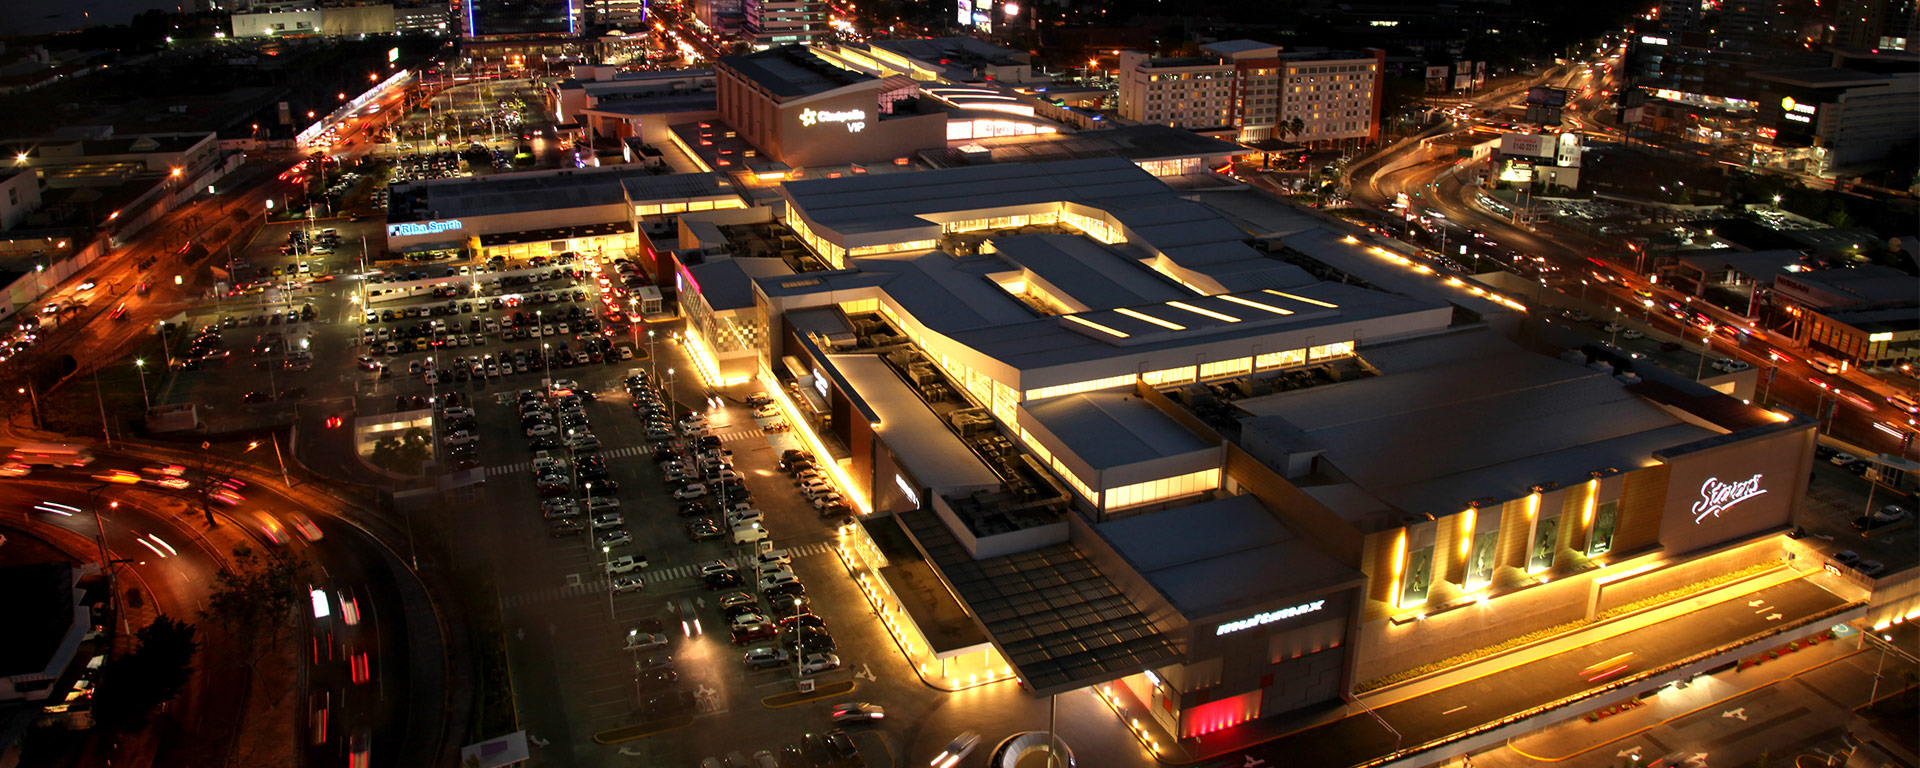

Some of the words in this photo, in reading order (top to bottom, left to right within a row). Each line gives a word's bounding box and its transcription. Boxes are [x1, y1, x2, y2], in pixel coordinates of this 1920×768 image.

[847, 121, 866, 132] VIP
[401, 223, 428, 235] Riba
[429, 220, 462, 233] Smith
